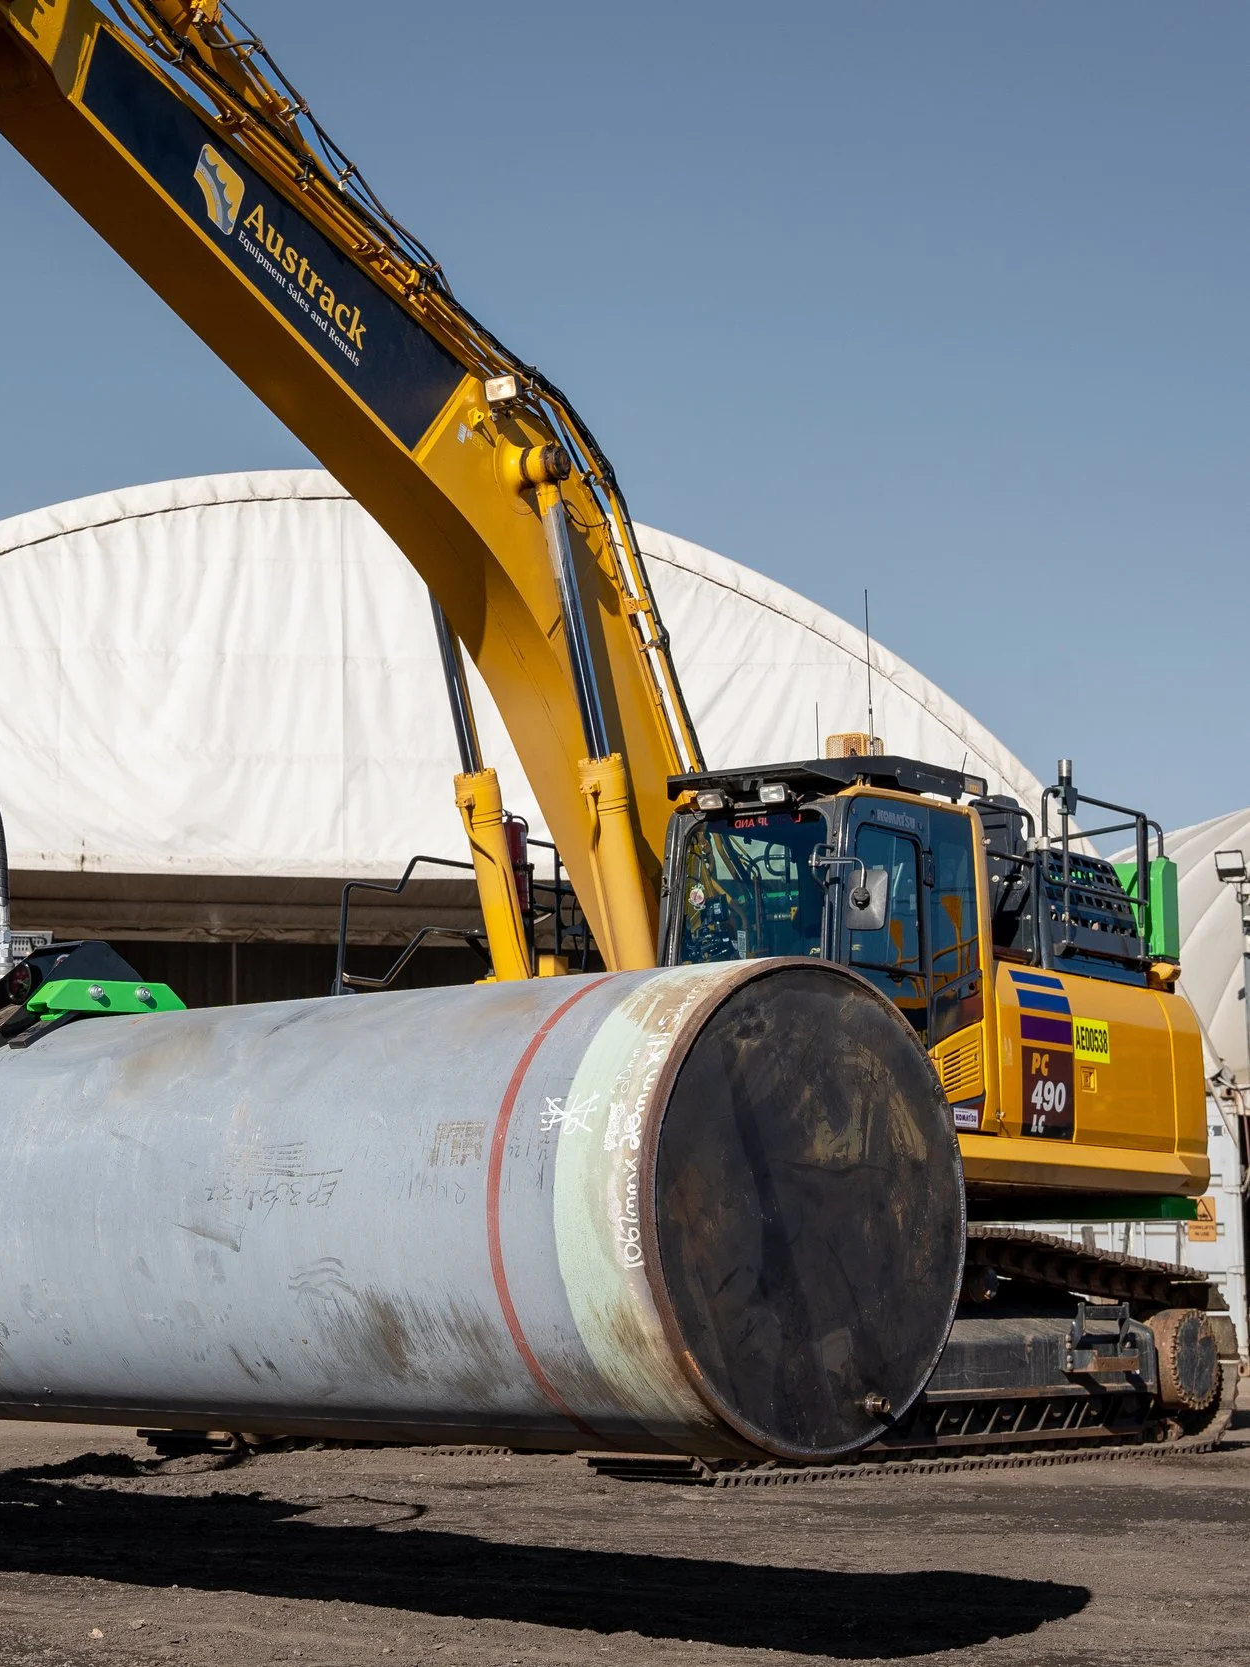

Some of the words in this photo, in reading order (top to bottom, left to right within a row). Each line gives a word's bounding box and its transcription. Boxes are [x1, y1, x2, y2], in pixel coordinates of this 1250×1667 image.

[243, 204, 367, 350] Austrack
[238, 230, 286, 288] Equipment
[287, 283, 309, 313] Sales
[310, 309, 328, 332] and
[328, 326, 360, 366] Rentals
[876, 809, 916, 828] KOMATSU
[1075, 1025, 1108, 1054] AE00538
[1031, 1052, 1050, 1077] PC
[1031, 1080, 1066, 1113] 490
[955, 1112, 977, 1123] KOMATSU
[1030, 1114, 1046, 1133] LC
